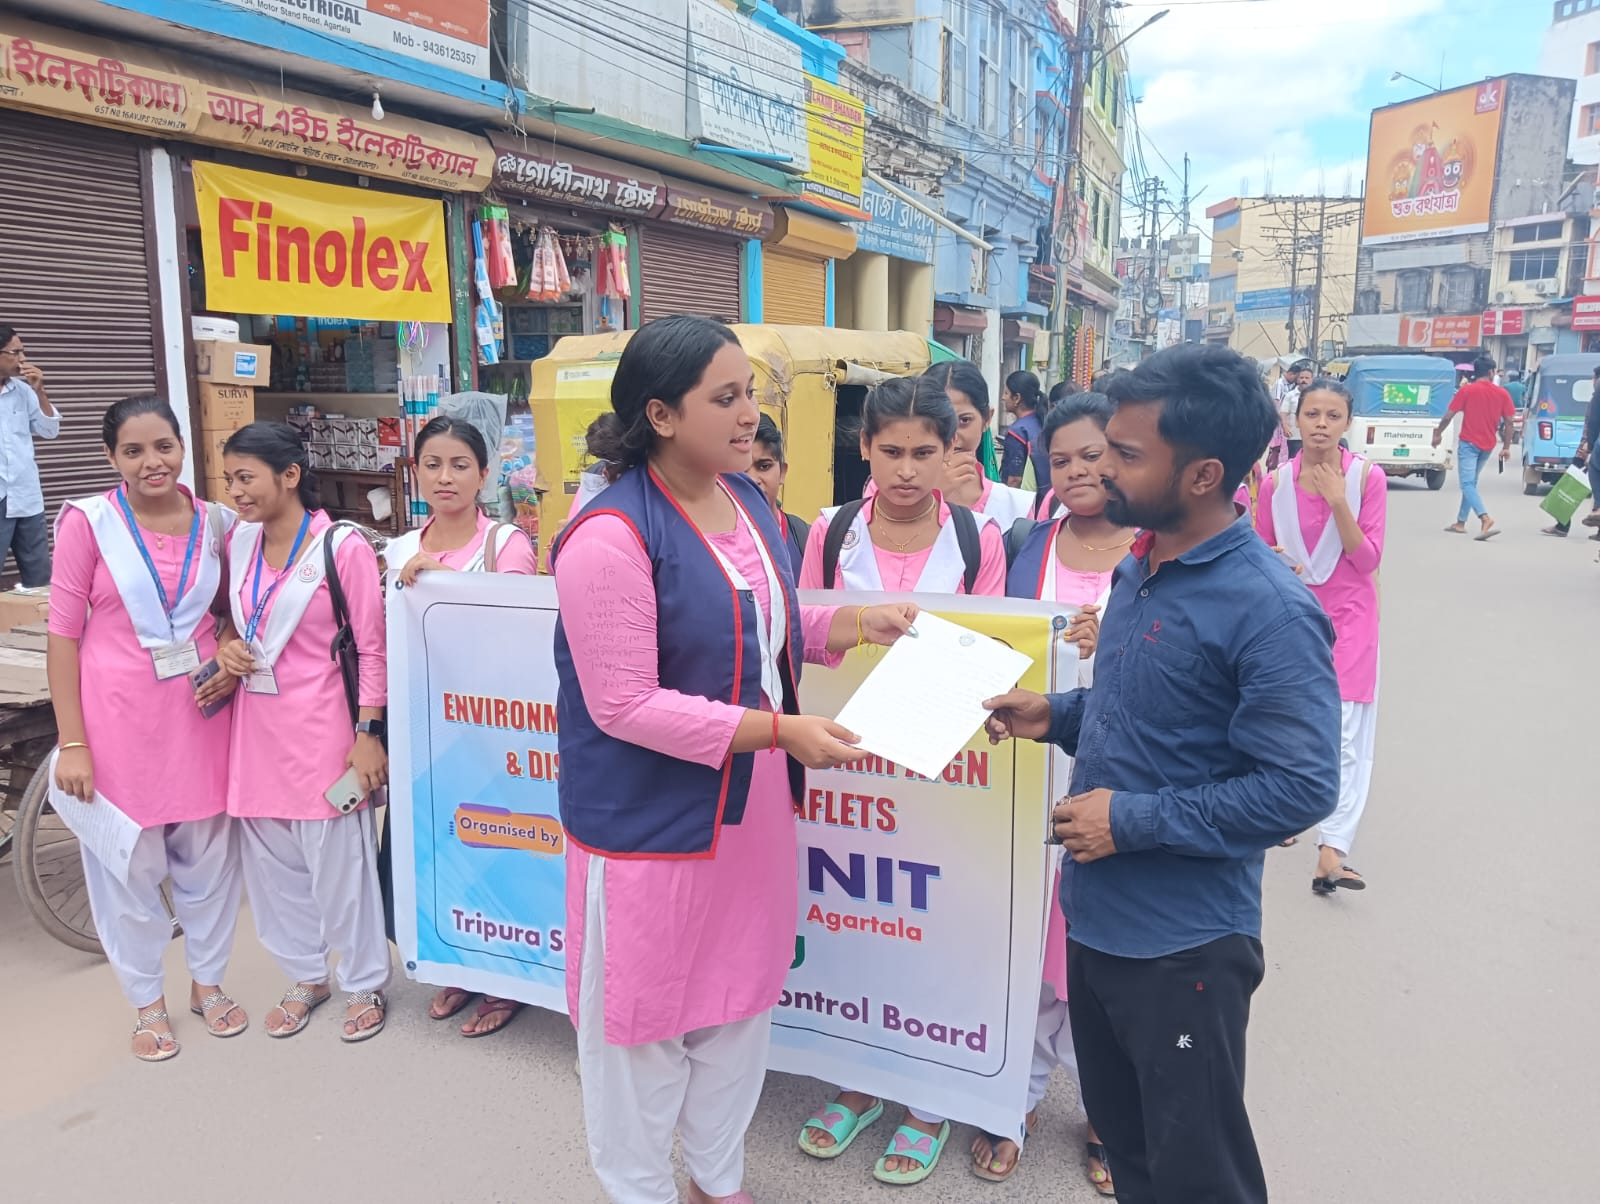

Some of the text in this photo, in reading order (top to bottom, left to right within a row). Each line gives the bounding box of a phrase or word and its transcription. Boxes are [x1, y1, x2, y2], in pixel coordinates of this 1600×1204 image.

[257, 0, 279, 15] Motor
[280, 6, 302, 20] Stand
[323, 19, 351, 34] Agartala
[392, 30, 415, 48] Mob
[422, 38, 477, 66] 9436125357
[95, 105, 110, 115] GST
[1392, 193, 1459, 216] শুভ রথযাত্রা
[218, 196, 433, 294] Finolex
[218, 389, 249, 400] SURYA
[506, 751, 522, 777] &
[460, 816, 559, 847] Organised by
[452, 909, 541, 948] Tripura
[806, 904, 922, 942] Agartala
[882, 1003, 988, 1053] Board
